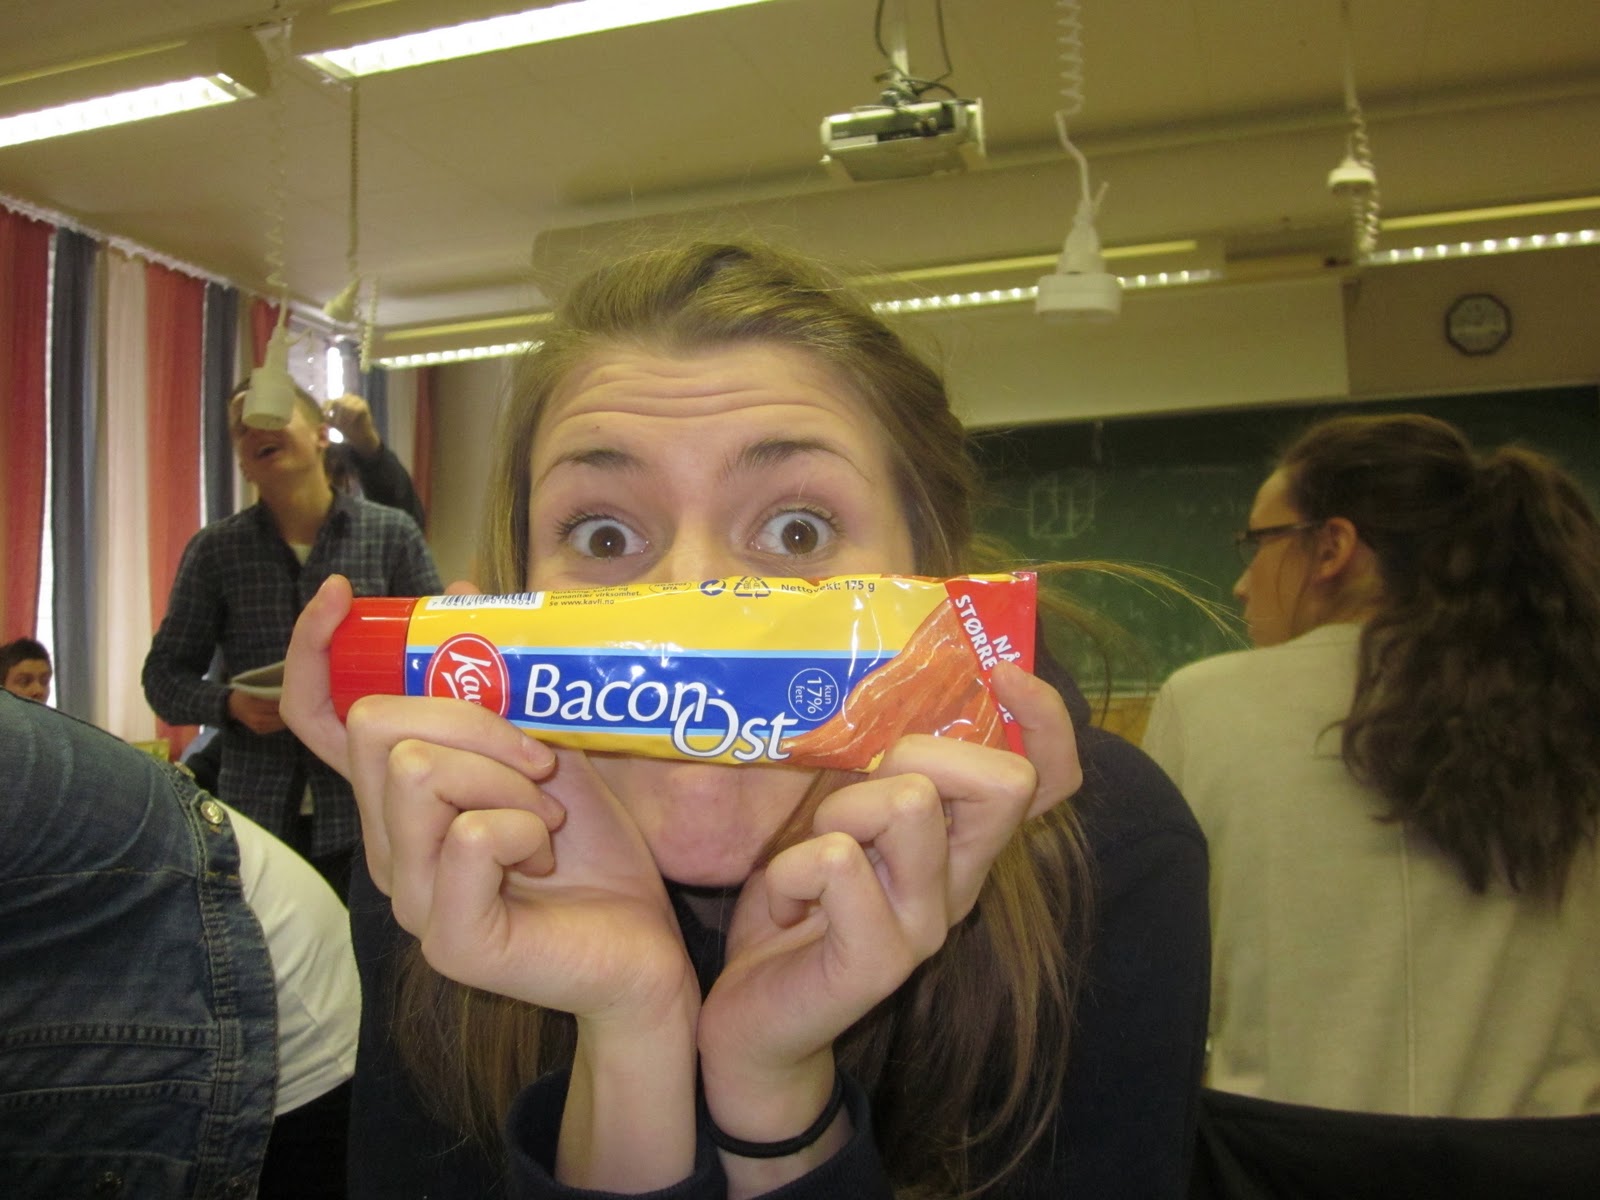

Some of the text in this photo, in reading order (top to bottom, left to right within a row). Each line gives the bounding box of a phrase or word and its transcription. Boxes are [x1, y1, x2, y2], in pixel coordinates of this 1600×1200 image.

[845, 580, 864, 590] 175
[868, 582, 875, 592] g
[561, 598, 615, 606] www.kavli.no
[955, 594, 998, 671] STØRRE
[992, 634, 1020, 663] NÅ
[524, 663, 708, 722] Bacon
[795, 685, 805, 704] fett
[807, 676, 823, 714] 17%
[824, 684, 835, 705] kun
[673, 698, 798, 761] Ost
